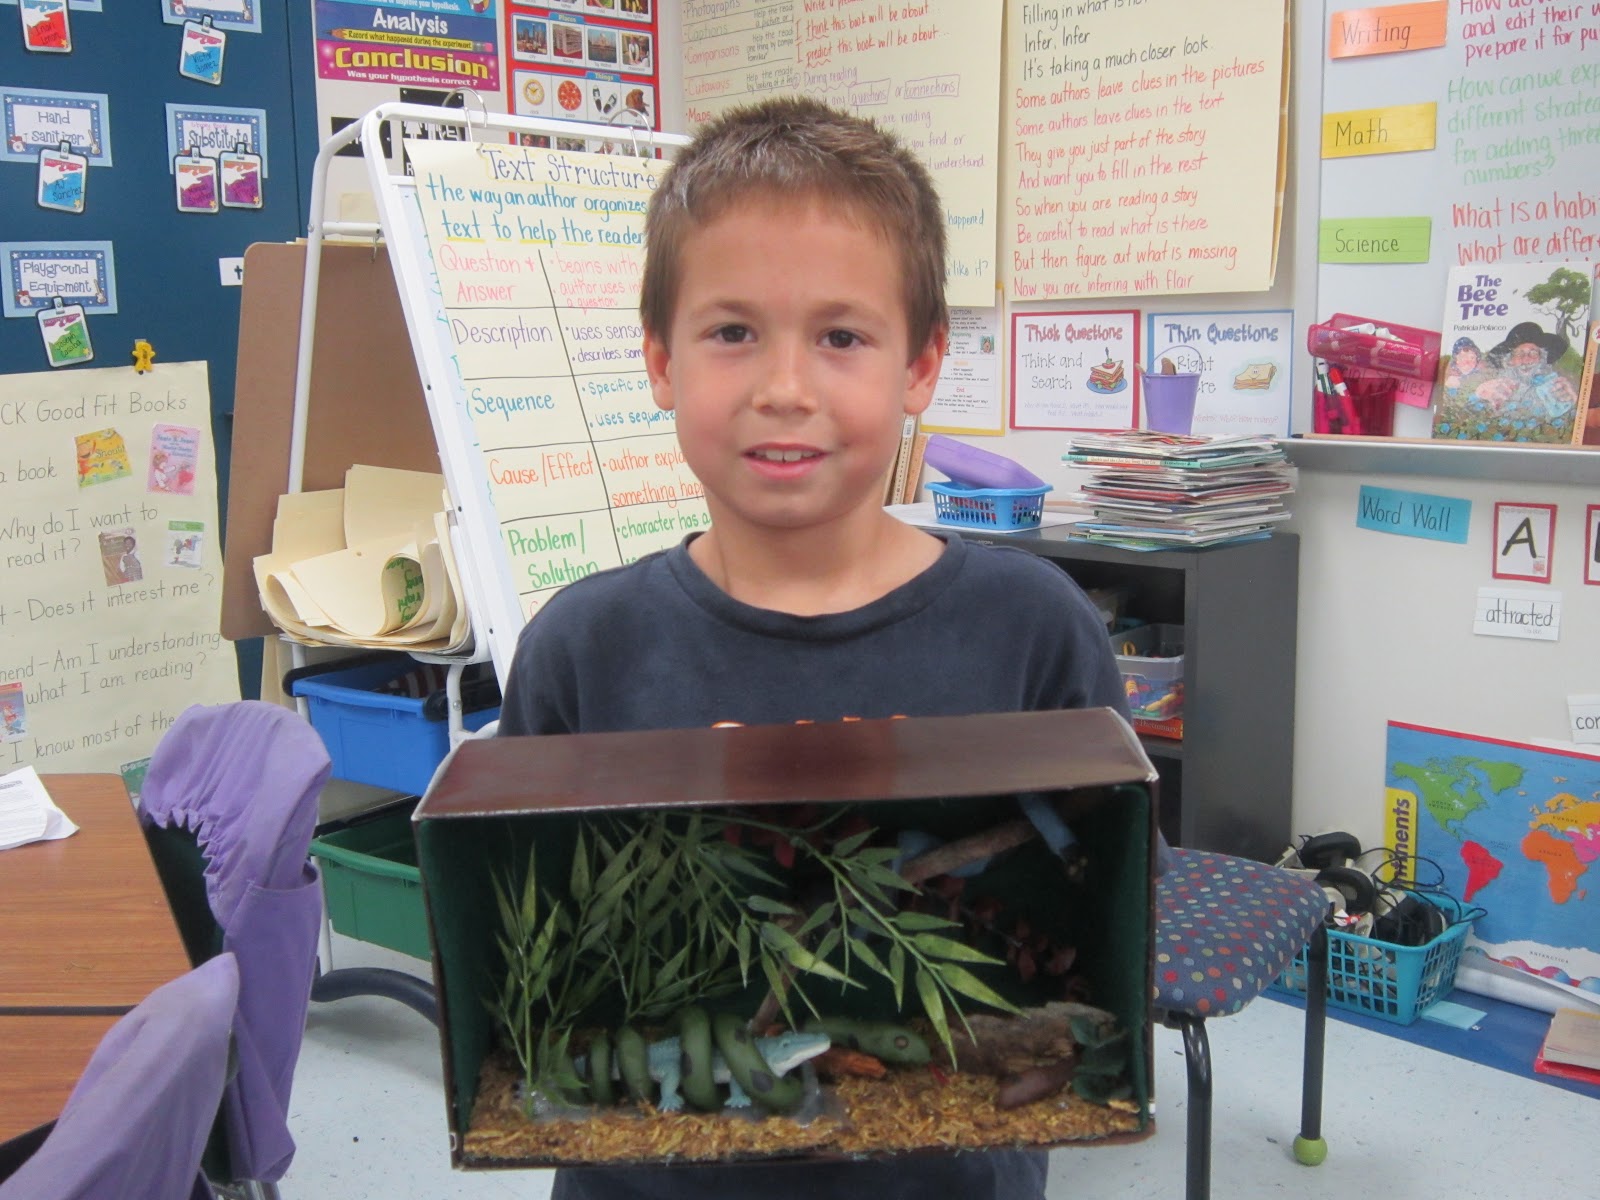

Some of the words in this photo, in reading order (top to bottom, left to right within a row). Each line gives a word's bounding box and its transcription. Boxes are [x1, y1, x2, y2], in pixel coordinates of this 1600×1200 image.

[372, 8, 449, 35] Analysis
[806, 18, 829, 37] think
[831, 13, 846, 31] this
[850, 10, 865, 29] book
[889, 6, 898, 21] be
[902, 4, 929, 19] about
[1342, 18, 1411, 49] Writing
[1462, 18, 1495, 40] and
[1506, 9, 1537, 31] edit
[1543, 3, 1583, 25] their
[1062, 25, 1091, 46] Infer
[1466, 37, 1527, 67] prepare
[1535, 28, 1544, 50] it
[1553, 25, 1573, 45] for
[335, 47, 489, 79] Conclusion
[1024, 58, 1044, 81] It's
[1050, 55, 1089, 81] taking
[1093, 58, 1101, 69] a
[1105, 48, 1137, 68] much
[1141, 44, 1176, 62] closer
[347, 70, 367, 78] Was
[368, 72, 389, 81] your
[390, 73, 440, 84] hypothesis
[441, 77, 470, 86] correct
[1016, 88, 1047, 109] Some
[1050, 81, 1091, 103] authors
[1098, 77, 1123, 100] leave
[1132, 70, 1162, 92] clues
[1165, 75, 1177, 88] in
[1181, 64, 1207, 84] the
[1213, 57, 1265, 90] pictures
[38, 111, 70, 124] Hand
[1448, 99, 1528, 133] different
[1336, 118, 1388, 146] Math
[934, 155, 985, 170] understand
[1454, 139, 1479, 164] for
[1486, 133, 1550, 161] adding
[482, 149, 536, 181] Text
[547, 153, 658, 190] Structure
[426, 172, 465, 201] the
[470, 189, 504, 214] way
[505, 191, 525, 205] an
[527, 183, 577, 208] author
[584, 196, 648, 222] organizes
[947, 208, 985, 230] happened
[1453, 198, 1503, 228] What
[1536, 204, 1547, 220] a
[441, 209, 481, 238] text
[491, 214, 512, 238] to
[518, 216, 557, 248] help
[562, 217, 594, 243] the
[598, 226, 643, 245] reader
[1335, 229, 1399, 252] Science
[23, 262, 89, 278] Playground
[439, 244, 521, 271] Question
[953, 261, 969, 277] like
[29, 279, 92, 293] Equipment
[456, 280, 515, 303] Answer
[560, 276, 598, 296] author
[600, 280, 626, 294] uses
[1014, 277, 1037, 297] Now
[1043, 282, 1059, 299] you
[1063, 282, 1081, 293] are
[1088, 275, 1128, 293] inferring
[1134, 270, 1159, 292] with
[1458, 285, 1497, 302] Bee
[1475, 275, 1502, 287] The
[1460, 303, 1508, 320] Tree
[452, 315, 553, 349] Description
[1065, 323, 1123, 343] Questions
[1164, 323, 1203, 343] Thin
[1207, 322, 1279, 342] Questions
[577, 348, 622, 363] describes
[1022, 352, 1055, 369] Think
[1060, 352, 1083, 369] and
[1177, 354, 1214, 372] Right
[37, 397, 85, 423] Good
[130, 391, 187, 414] Books
[471, 387, 555, 421] Sequence
[595, 411, 624, 427] uses
[608, 448, 649, 472] author
[612, 480, 676, 508] something
[0, 518, 35, 545] Why
[43, 512, 63, 535] do
[66, 508, 81, 531] I
[90, 504, 132, 528] want
[140, 502, 158, 521] to
[621, 510, 675, 539] character
[677, 511, 699, 529] has
[1362, 495, 1402, 524] Word
[1413, 503, 1451, 532] Wall
[1502, 517, 1537, 558] A
[7, 543, 45, 568] read
[53, 537, 81, 561] it?
[528, 558, 599, 589] Solution
[27, 598, 75, 621] Does
[81, 591, 95, 612] it
[107, 584, 166, 608] interest
[1486, 598, 1554, 627] attracted
[53, 649, 82, 672] Am
[88, 642, 100, 665] I
[109, 631, 221, 661] understanding
[26, 682, 67, 705] what
[80, 671, 91, 695] I
[100, 674, 125, 689] am
